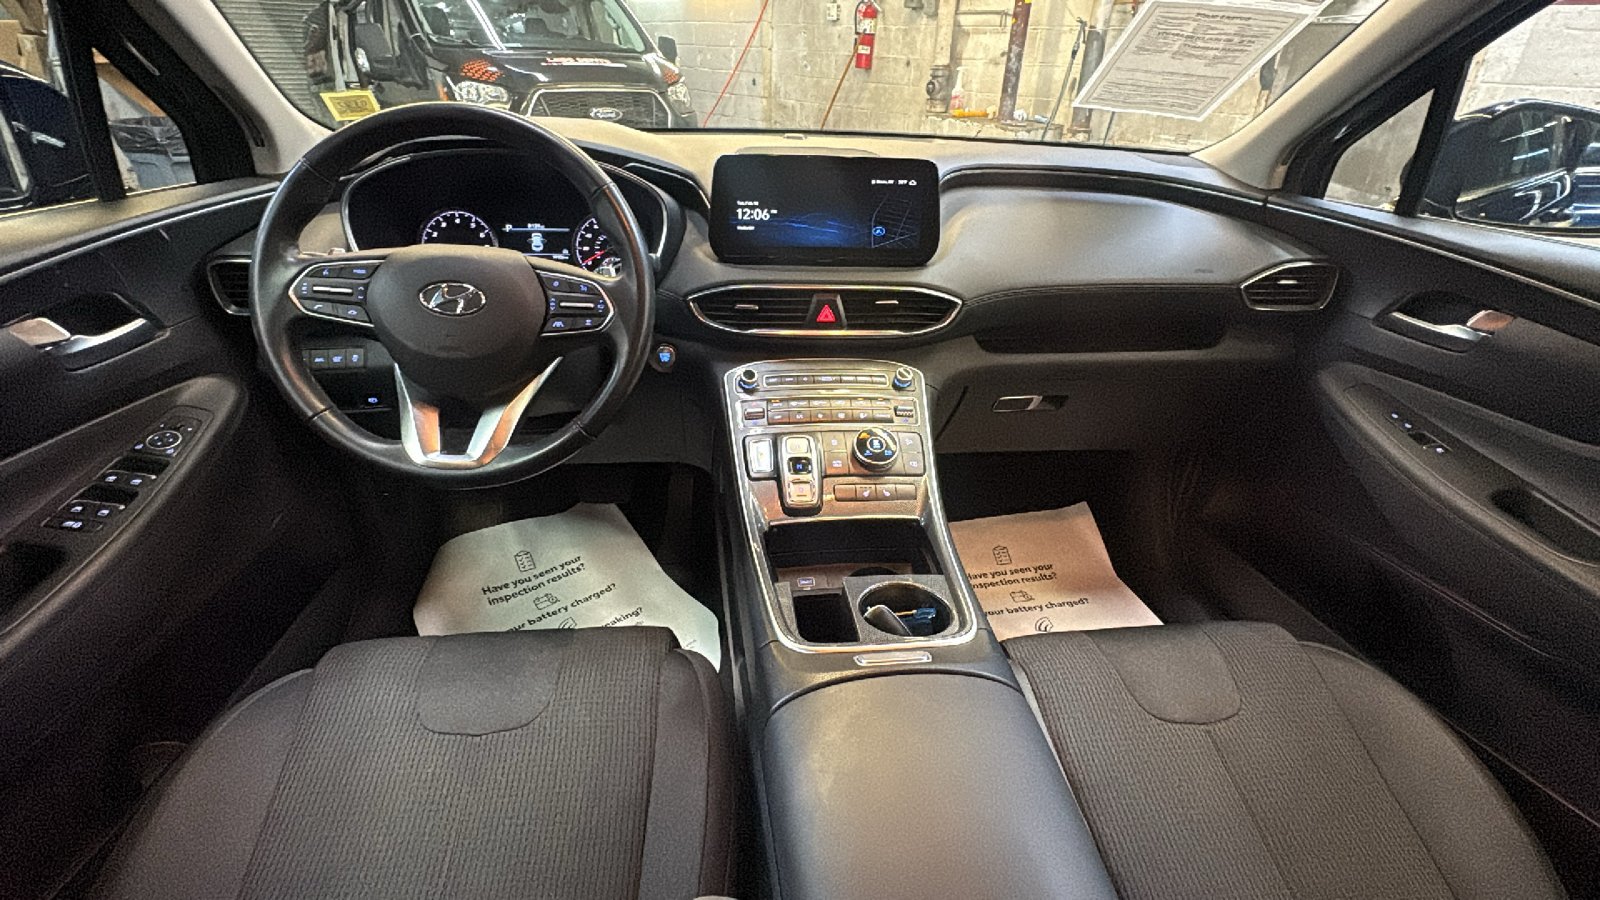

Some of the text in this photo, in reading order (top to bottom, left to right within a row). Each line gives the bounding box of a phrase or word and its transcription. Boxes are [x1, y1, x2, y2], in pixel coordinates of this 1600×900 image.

[736, 208, 770, 220] 12:06
[482, 556, 581, 595] Have you seen your
[990, 569, 1008, 579] you
[1009, 566, 1032, 575] seen
[1032, 563, 1053, 573] your
[487, 563, 586, 605] inspection results?
[972, 572, 1057, 589] nspection results?
[527, 605, 568, 625] battery
[570, 582, 617, 607] charged?
[1005, 604, 1043, 614] battery
[1045, 597, 1090, 609] charged?
